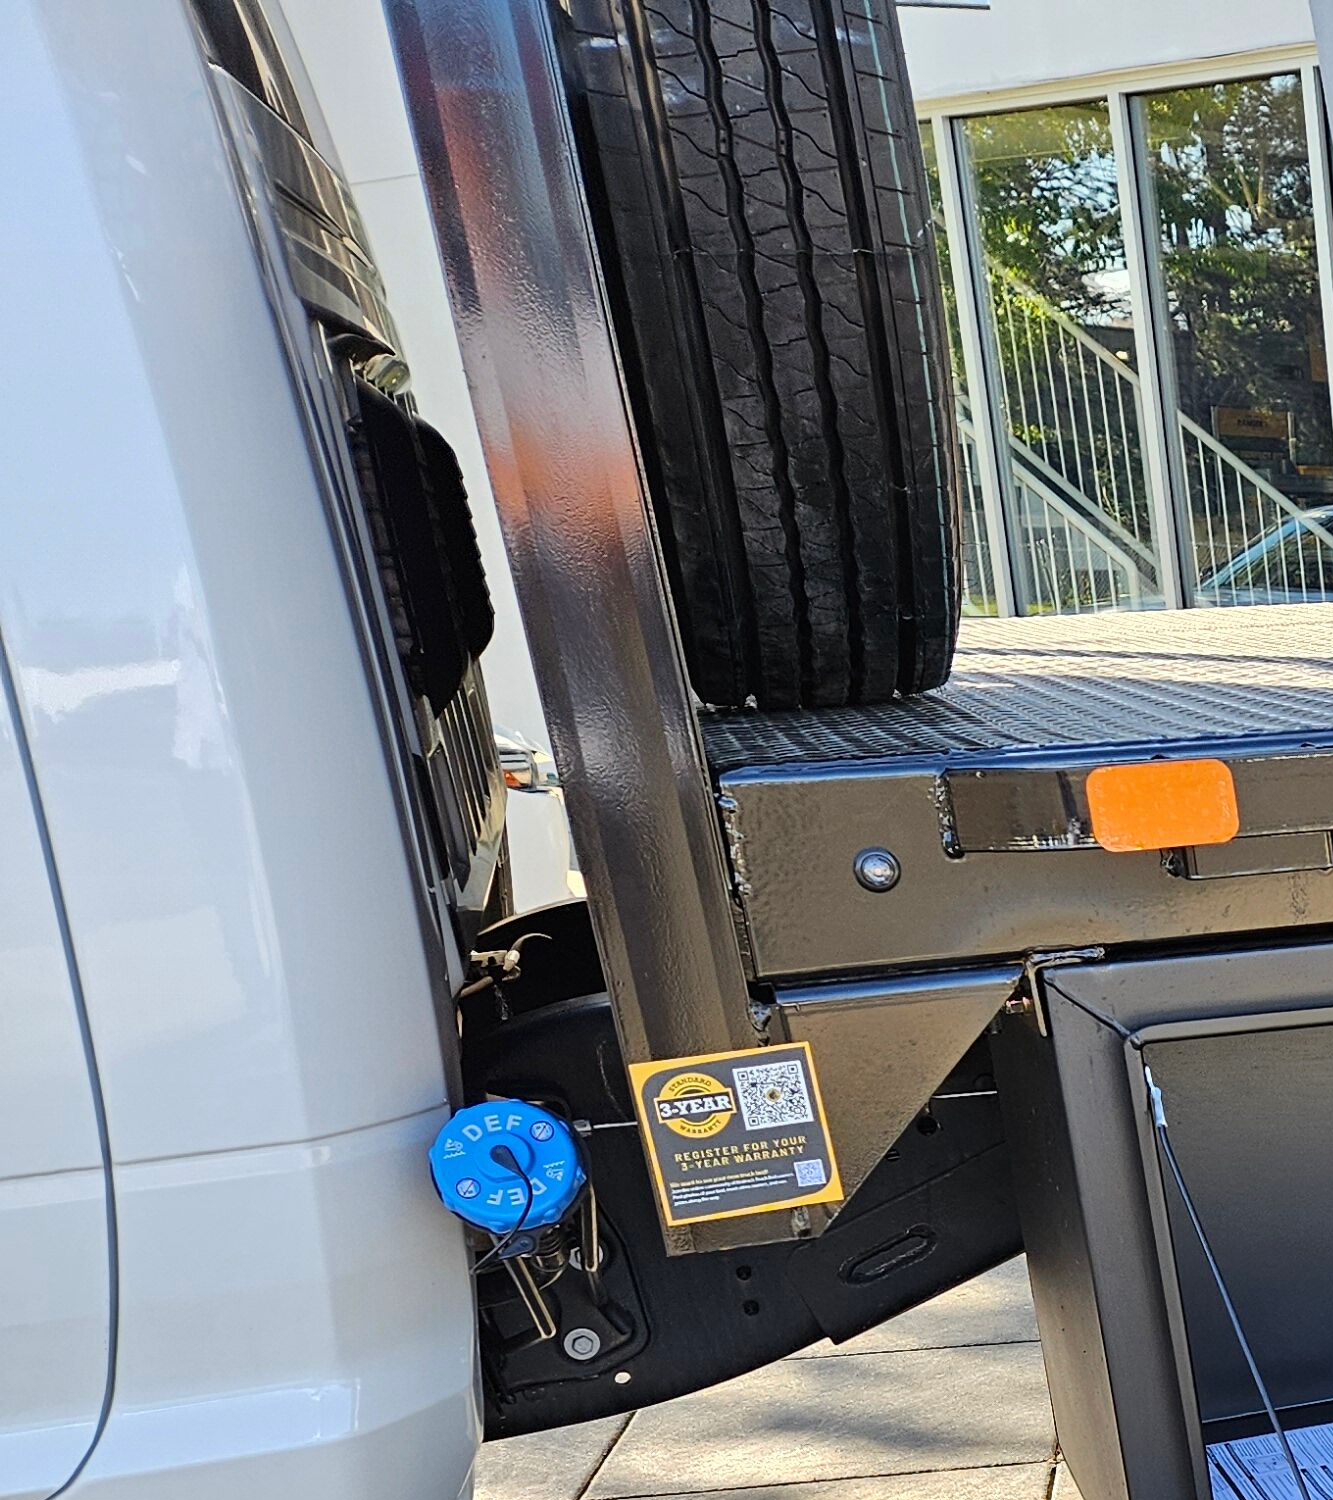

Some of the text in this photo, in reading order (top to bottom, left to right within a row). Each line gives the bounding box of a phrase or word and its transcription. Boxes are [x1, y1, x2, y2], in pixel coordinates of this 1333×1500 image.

[668, 1077, 712, 1092] STANDARD
[659, 1095, 733, 1118] 3-YEAR
[462, 1114, 523, 1142] DEF
[680, 1119, 722, 1134] WARRANTY
[674, 1135, 807, 1162] REGISTER FOR YOUR
[681, 1145, 804, 1172] 3-YEAR WARRANTY
[486, 1177, 548, 1206] DEF
